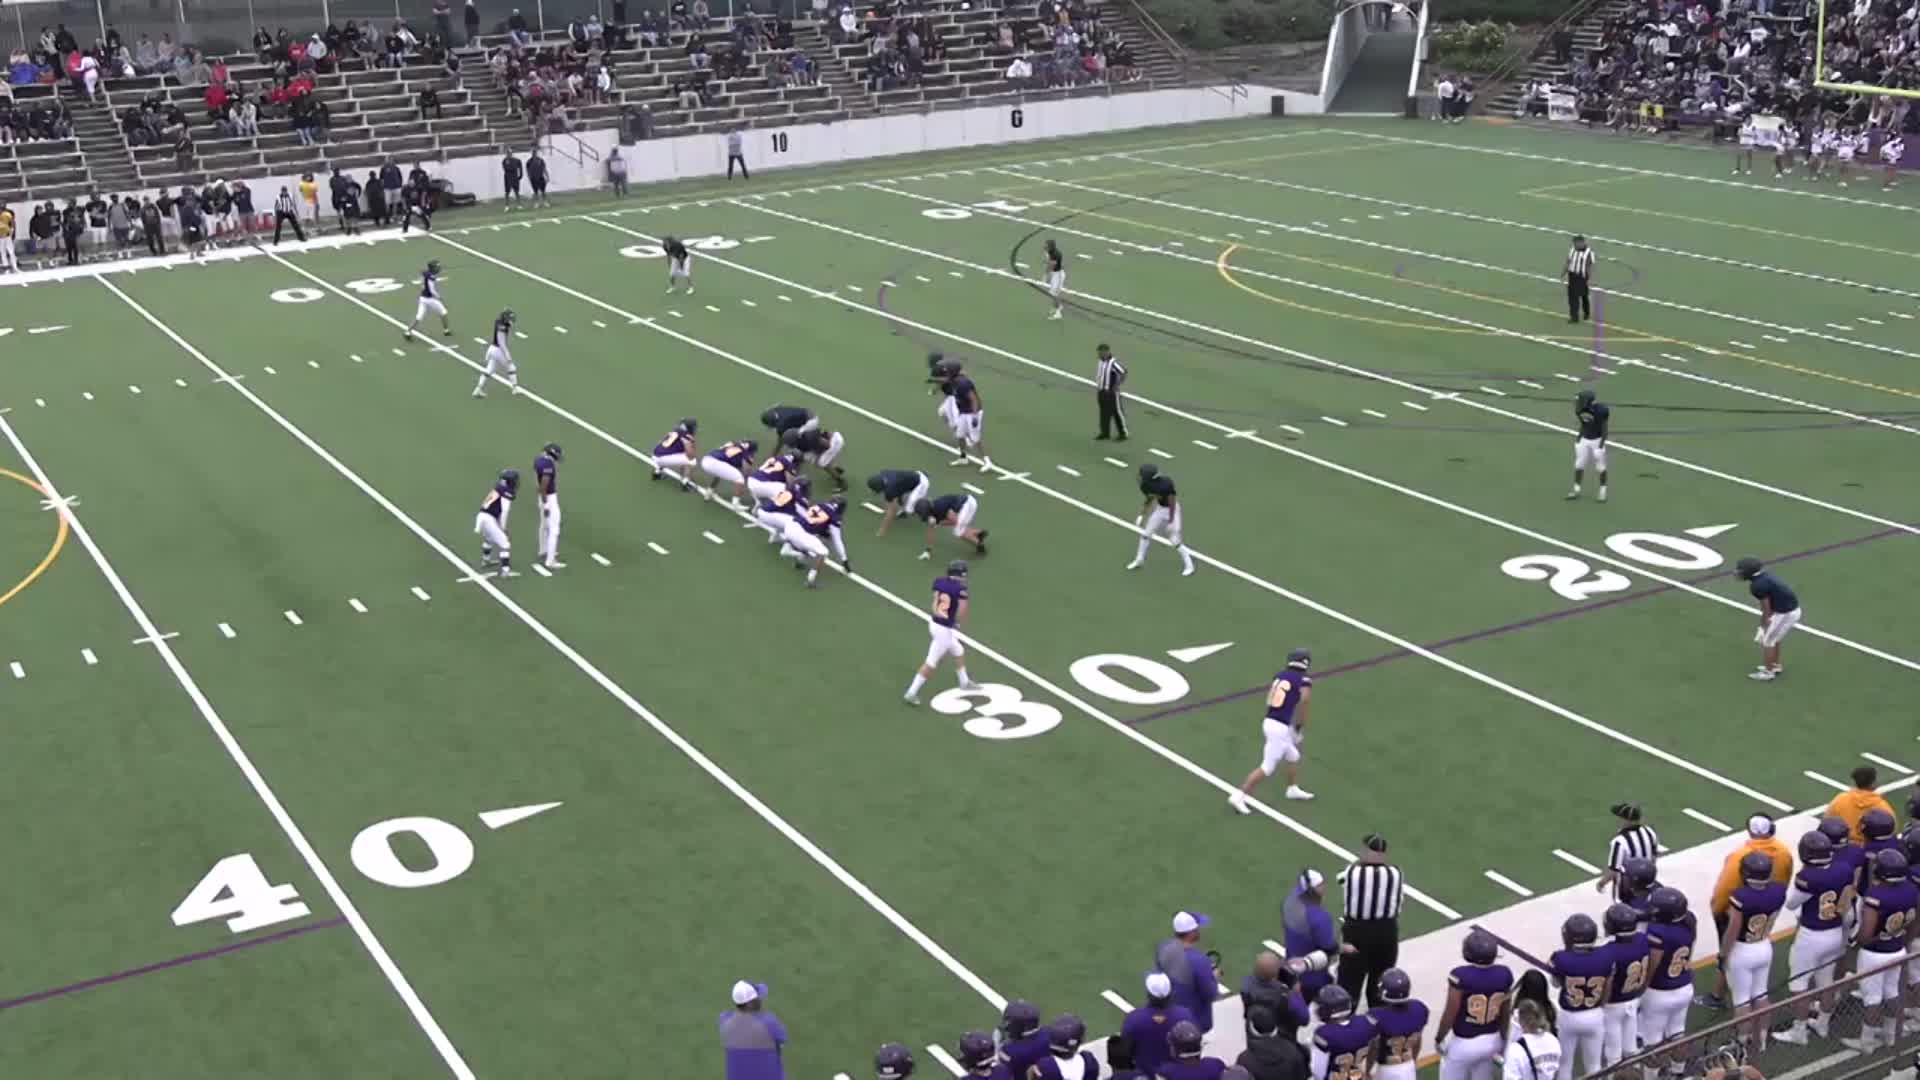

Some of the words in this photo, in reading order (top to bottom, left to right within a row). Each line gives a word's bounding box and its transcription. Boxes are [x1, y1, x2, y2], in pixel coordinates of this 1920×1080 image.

[771, 132, 789, 152] 10
[1500, 531, 1725, 601] 20
[929, 653, 1191, 739] 30
[170, 816, 475, 934] 40
[1565, 975, 1605, 1008] 53
